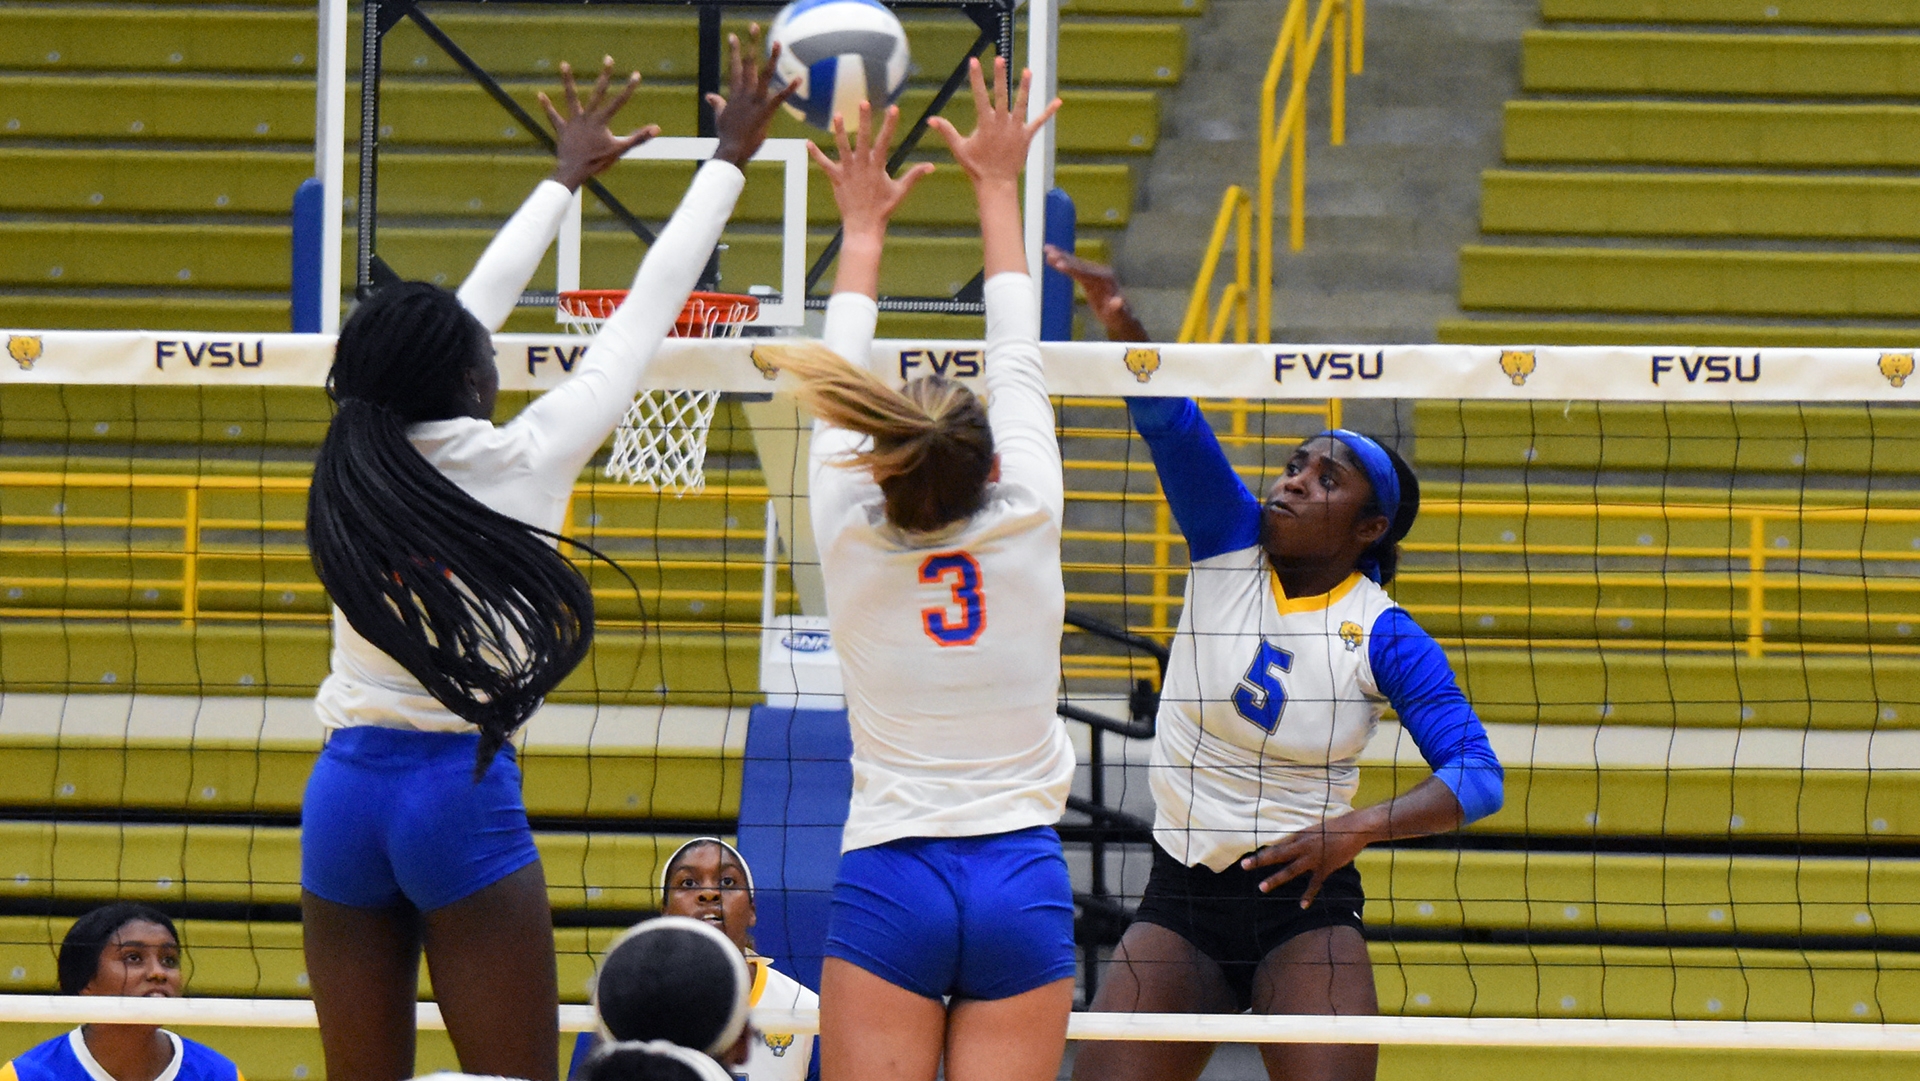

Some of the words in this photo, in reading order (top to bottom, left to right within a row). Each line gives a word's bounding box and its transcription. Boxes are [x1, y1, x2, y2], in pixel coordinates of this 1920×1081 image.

[156, 339, 264, 371] FVSU
[527, 345, 588, 377] FV
[900, 350, 986, 380] FVS
[1275, 350, 1383, 384] FVSU
[1652, 353, 1760, 386] FVSU
[918, 550, 987, 647] 3
[1231, 636, 1295, 736] 5
